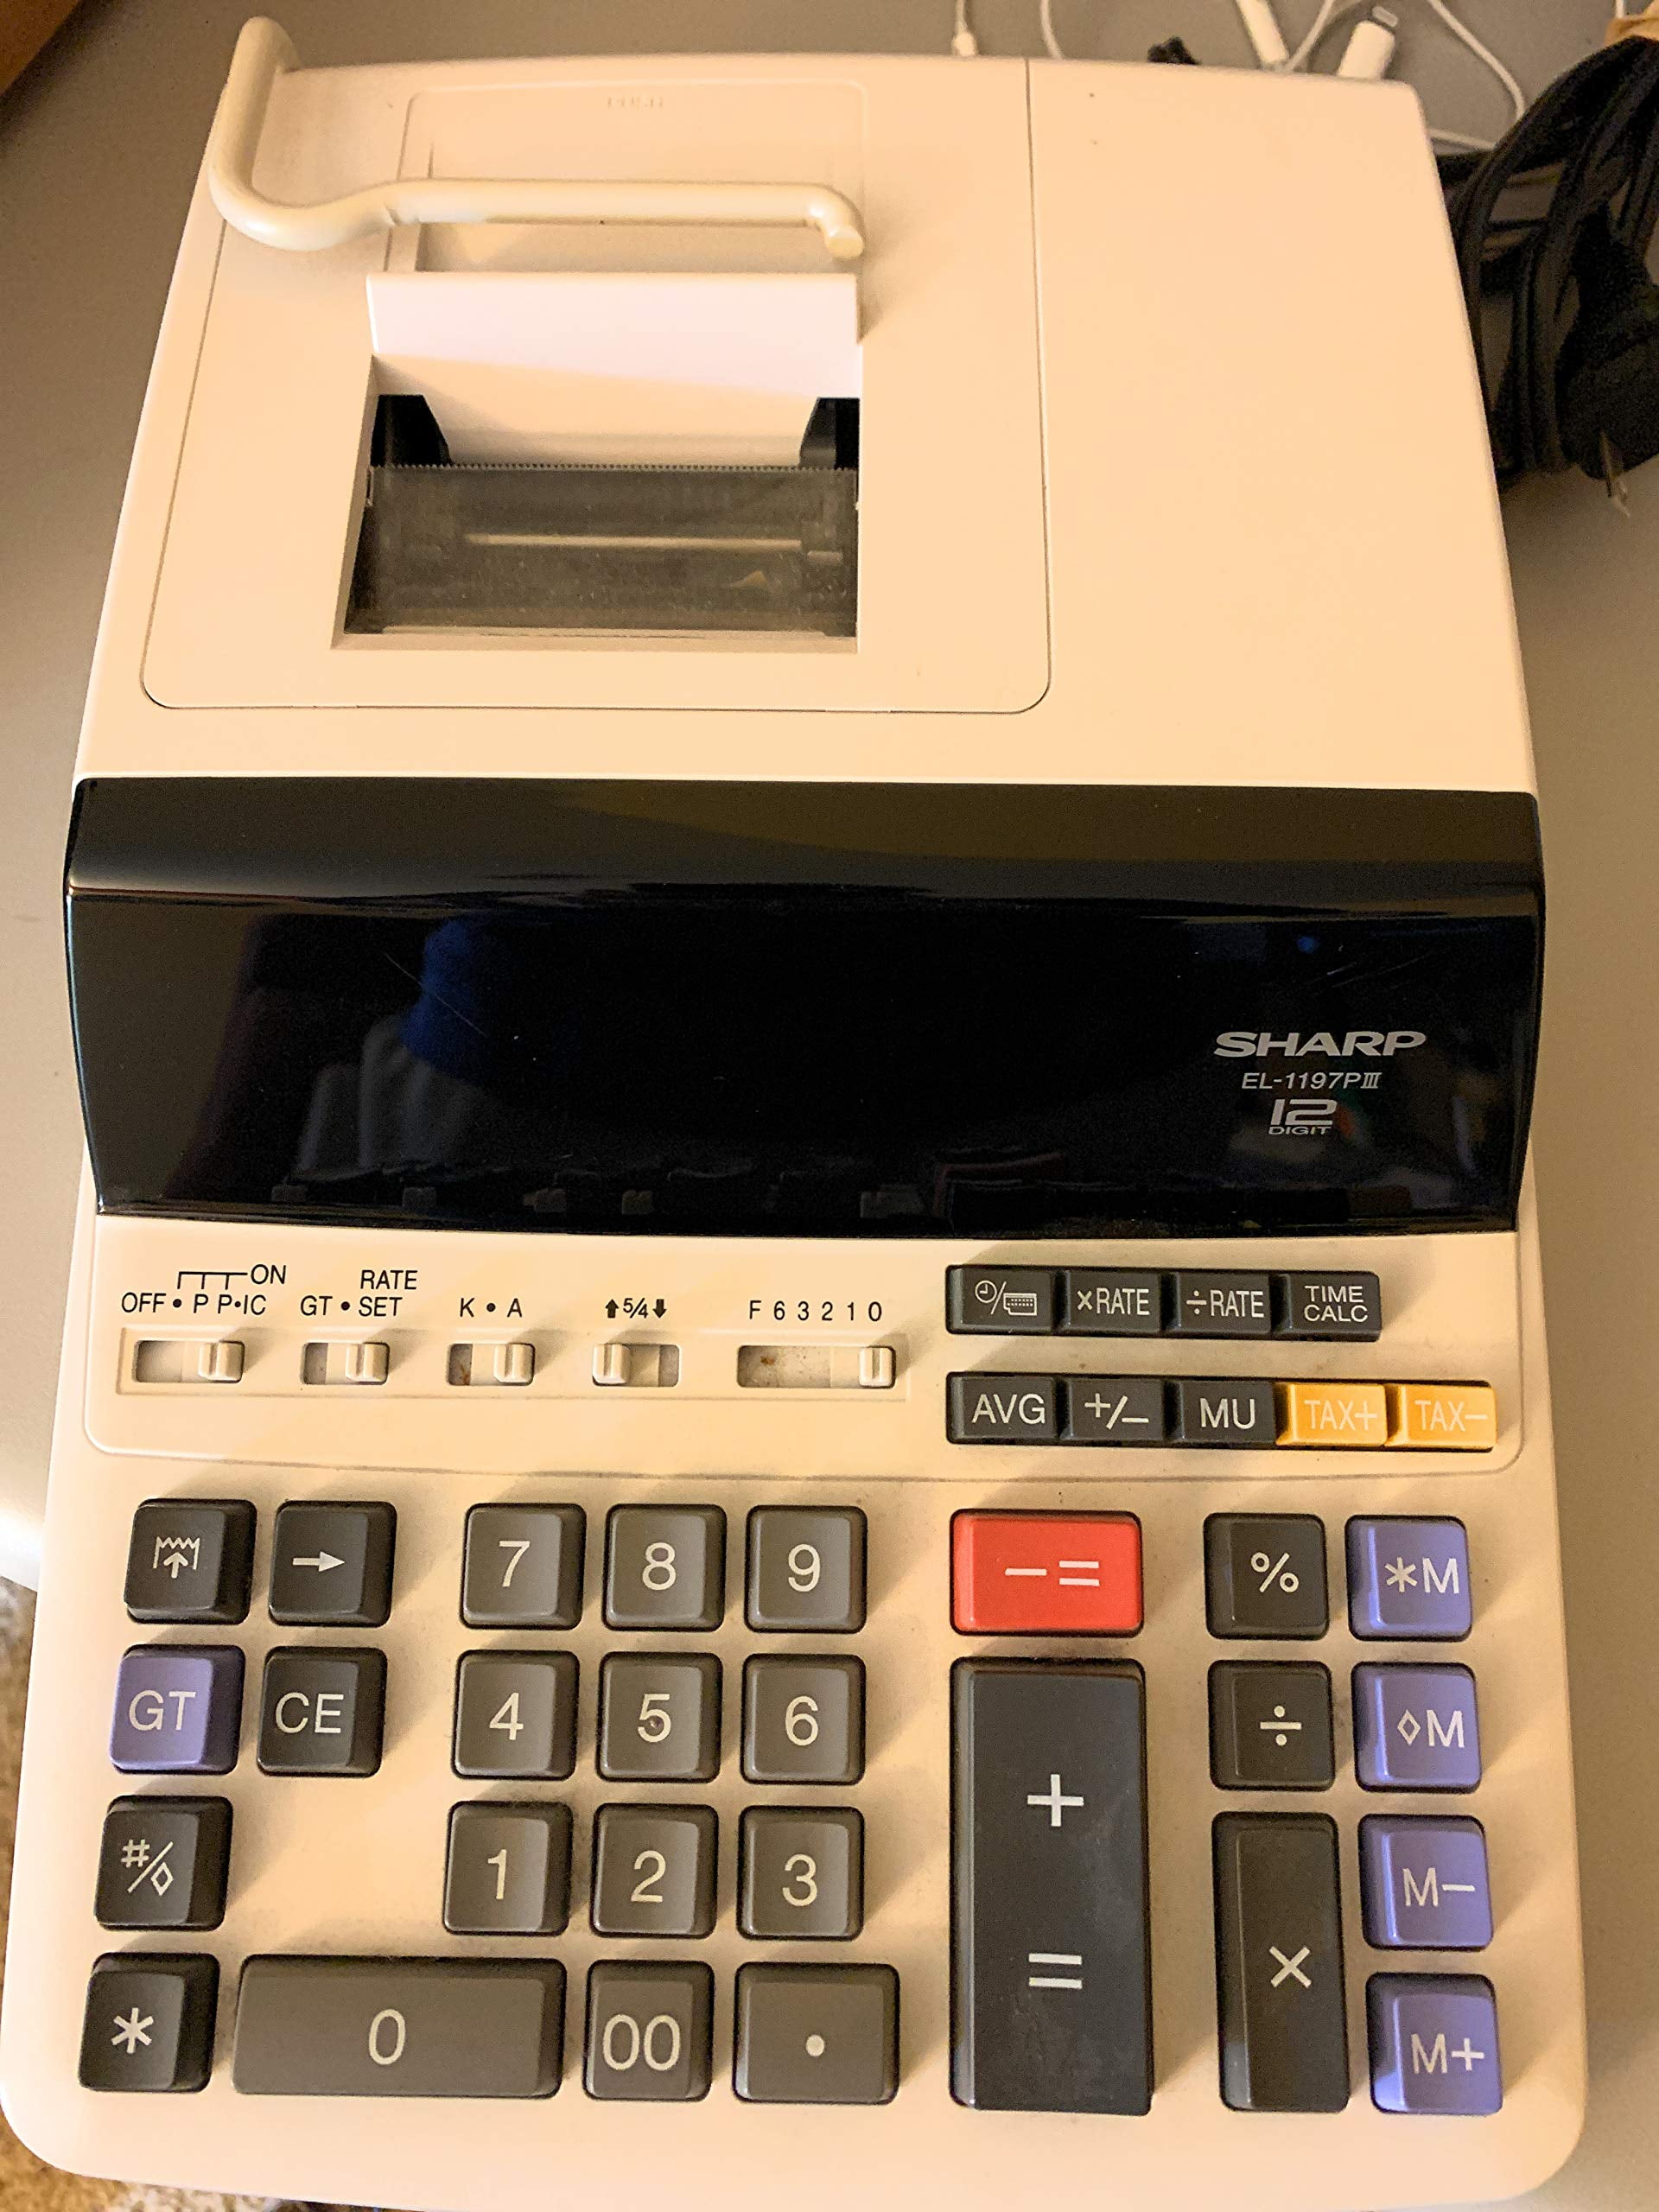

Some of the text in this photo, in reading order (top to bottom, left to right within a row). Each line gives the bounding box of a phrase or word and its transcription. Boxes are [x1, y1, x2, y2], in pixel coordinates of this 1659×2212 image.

[1213, 1031, 1427, 1058] SHARP
[1268, 1126, 1332, 1135] DIGIT
[1270, 1098, 1338, 1126] 12
[250, 1264, 287, 1285] ON
[359, 1269, 418, 1290] RATE
[121, 1293, 167, 1313] OFF
[193, 1294, 209, 1314] P
[300, 1295, 403, 1318] GT SET
[459, 1298, 523, 1318] K A
[749, 1300, 882, 1322] F 6 3 2 1 0
[1303, 1305, 1368, 1323] CALC
[1304, 1286, 1363, 1304] TIME
[971, 1394, 1046, 1425] AVG
[1200, 1397, 1255, 1429] MU
[1305, 1399, 1377, 1432] TAX+
[499, 1541, 531, 1587] 7
[642, 1542, 677, 1591] 8
[788, 1543, 821, 1592] 9
[1250, 1552, 1300, 1592] %
[129, 1690, 196, 1731] GT
[275, 1693, 344, 1733] CE
[489, 1693, 524, 1740] 4
[638, 1694, 671, 1743] 5
[785, 1695, 818, 1746] 6
[487, 1849, 508, 1899] 1
[631, 1850, 667, 1903] 2
[782, 1854, 818, 1906] 3
[368, 2008, 406, 2065] 0
[602, 2014, 681, 2071] 00
[1410, 2034, 1484, 2075] M+
